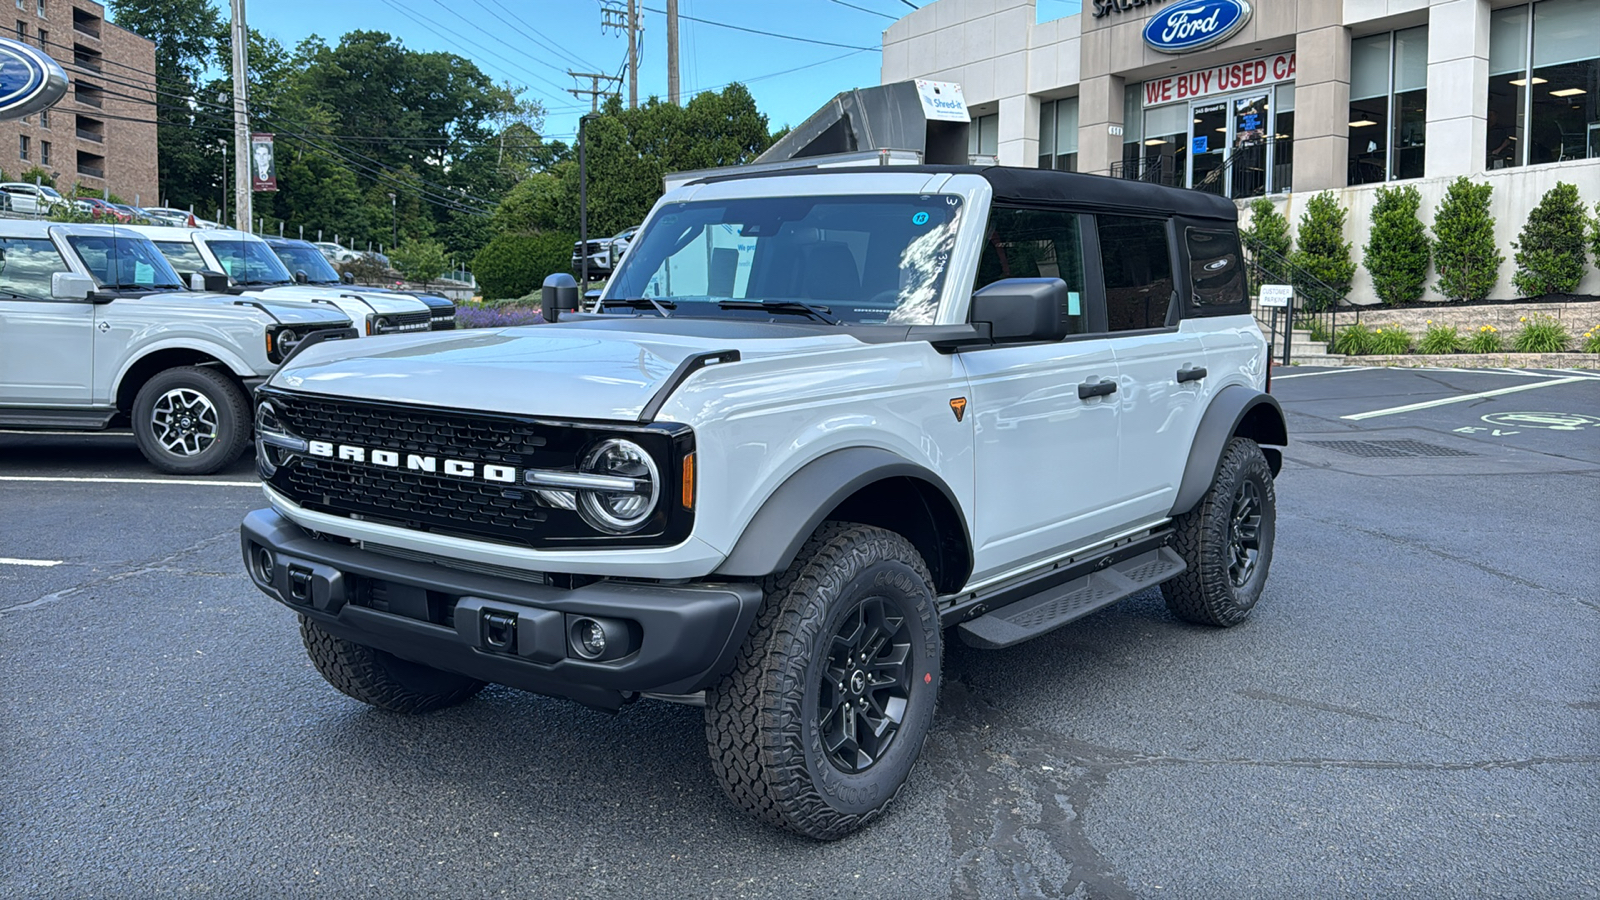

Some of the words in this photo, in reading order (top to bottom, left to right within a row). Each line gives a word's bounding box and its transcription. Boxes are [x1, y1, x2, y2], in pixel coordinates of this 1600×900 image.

[1162, 6, 1221, 43] Ford
[1146, 78, 1172, 104] WE
[1177, 70, 1213, 99] BUY
[1218, 60, 1267, 91] USED
[934, 98, 963, 109] Shred-it
[1262, 287, 1290, 295] CUSTOMER
[1264, 296, 1287, 304] PARKING
[309, 440, 516, 483] BRONCO
[873, 568, 936, 659] GOODYEAR
